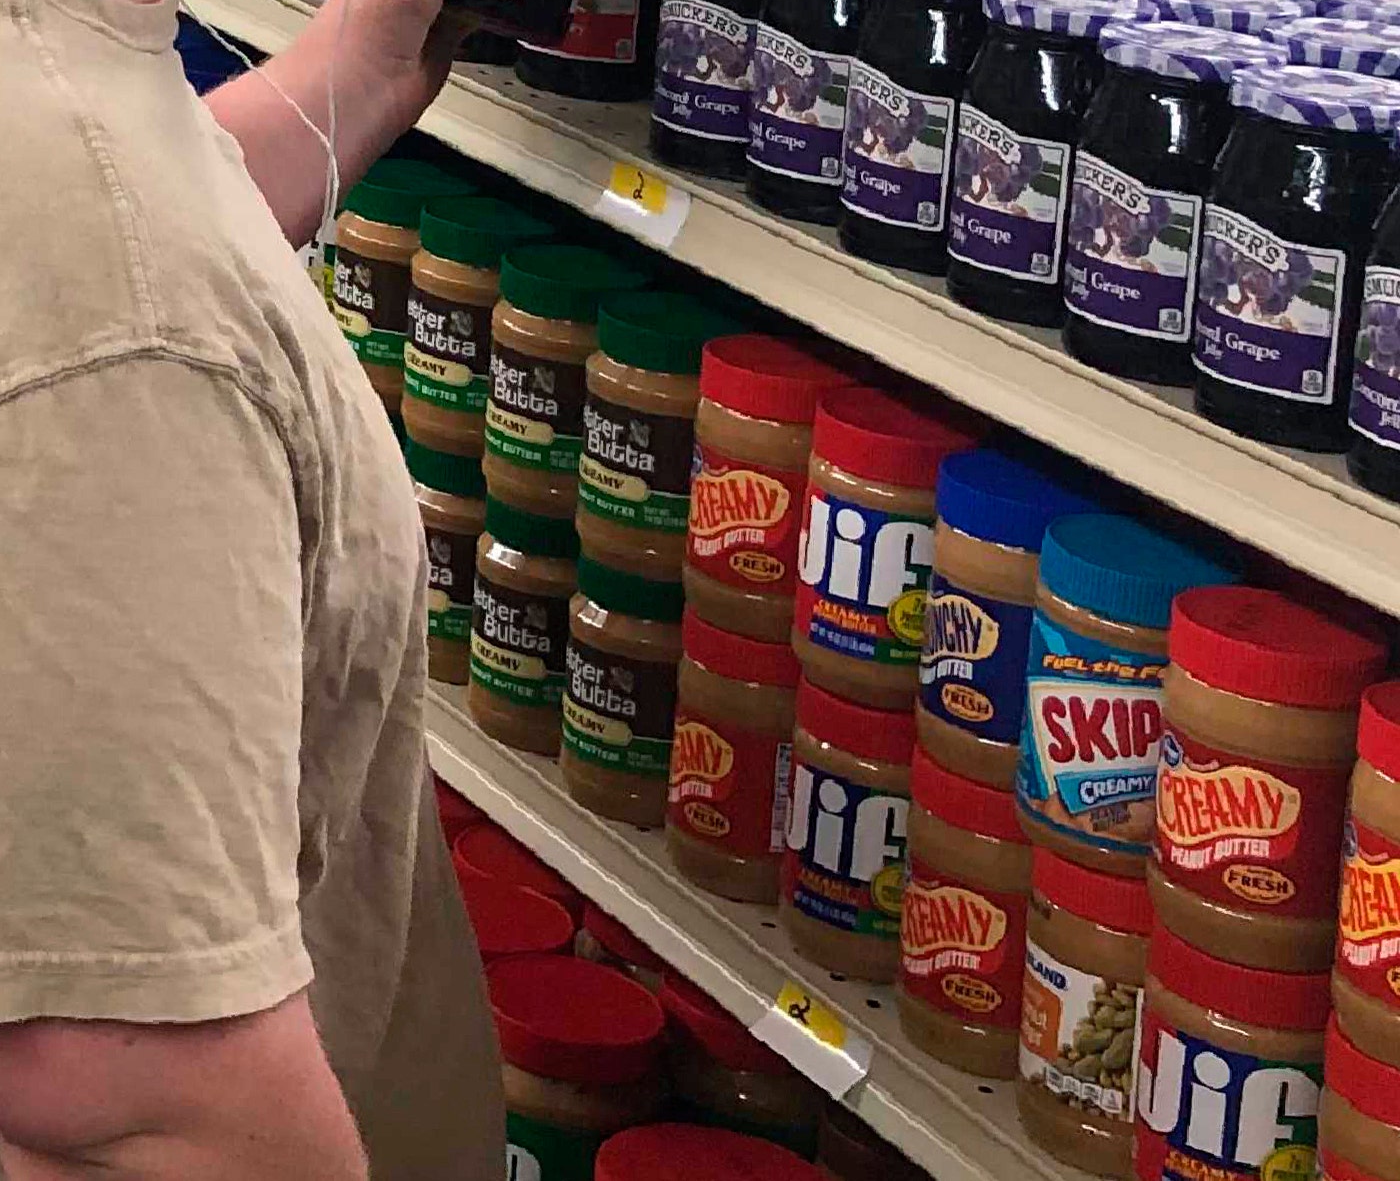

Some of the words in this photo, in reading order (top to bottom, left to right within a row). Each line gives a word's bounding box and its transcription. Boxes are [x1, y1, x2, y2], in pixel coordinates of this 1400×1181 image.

[694, 94, 741, 116] Grape
[765, 126, 807, 152] Grape
[632, 170, 644, 200] 2
[859, 170, 901, 197] Grape
[967, 217, 1013, 245] Grape
[1091, 271, 1141, 301] Grape
[414, 323, 476, 357] Butta
[1225, 332, 1282, 361] Grape
[421, 384, 458, 403] BUTTER
[494, 377, 559, 417] Butta
[587, 431, 656, 473] Butta
[723, 528, 766, 550] BUTTER
[798, 495, 935, 609] Jif
[732, 557, 781, 576] FRESH
[473, 589, 521, 623] etter
[483, 616, 551, 654] Butta
[927, 601, 983, 656] NCHY
[571, 675, 637, 717] Butta
[944, 686, 990, 716] FRESH
[1041, 694, 1161, 764] SKIP
[1079, 774, 1154, 806] CREAMY
[1159, 770, 1285, 839] CREAMY
[785, 764, 910, 883] Jif
[1170, 846, 1214, 869] PEANUT
[1214, 838, 1271, 860] BUTTER
[1227, 871, 1289, 894] FRESH
[934, 950, 982, 970] BUTTER
[1027, 950, 1068, 991] LAND
[945, 981, 996, 1003] FRESH
[1138, 1028, 1320, 1167] Jif
